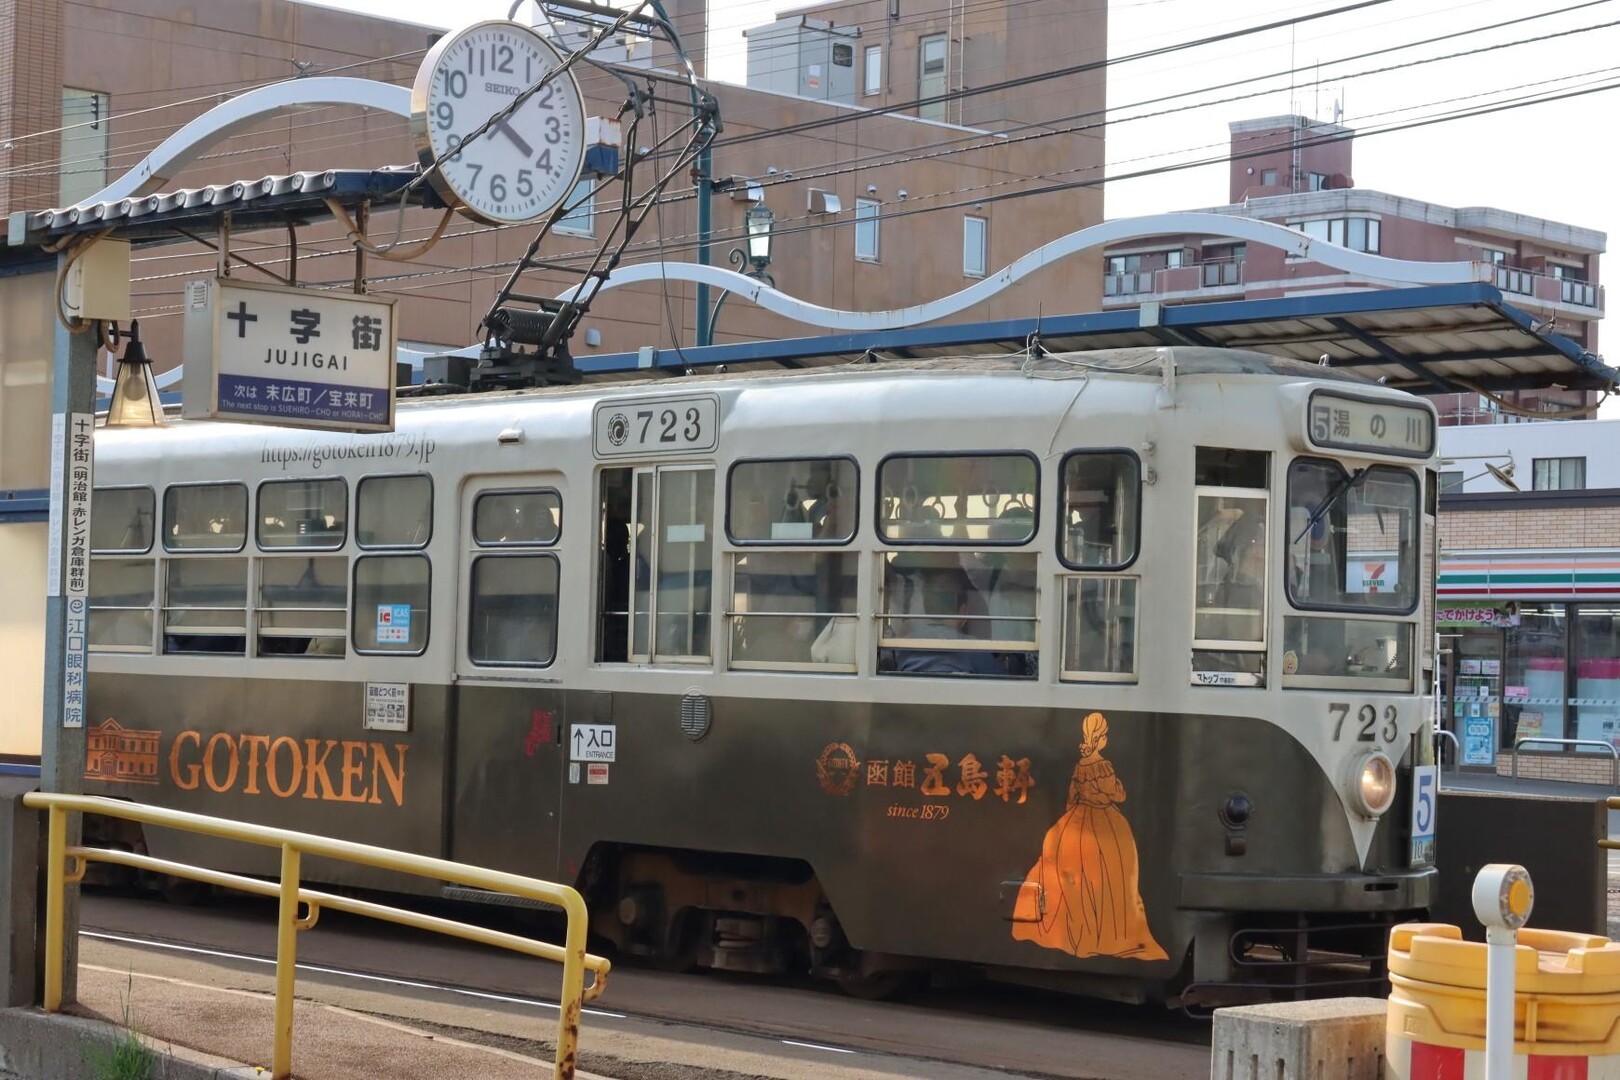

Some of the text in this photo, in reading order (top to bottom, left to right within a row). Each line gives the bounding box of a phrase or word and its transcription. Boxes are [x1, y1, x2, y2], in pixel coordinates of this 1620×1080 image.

[468, 47, 485, 77] 11
[491, 43, 514, 74] 12
[526, 56, 531, 84] 1
[443, 69, 467, 99] 10
[485, 82, 521, 97] SEIKO
[538, 81, 554, 110] 2
[436, 102, 454, 130] 9
[544, 116, 561, 145] 3
[535, 148, 553, 175] 4
[466, 163, 483, 191] 7
[490, 174, 507, 202] 6
[516, 169, 533, 197] 5
[226, 301, 383, 352] 十字街
[264, 348, 348, 371] JUJIGAI
[222, 400, 235, 409] The
[236, 402, 252, 410] next
[253, 403, 269, 412] stop
[233, 384, 258, 399] 次は
[637, 407, 701, 443] 723
[1313, 408, 1421, 446] 5 湯の川
[261, 431, 436, 470] https://gotoken1879.jp
[65, 618, 84, 723] 江口眼科病院
[1329, 702, 1398, 744] 723
[587, 728, 613, 748] 入口
[168, 730, 409, 807] GOTOKEN
[585, 750, 613, 759] ENTRANCE
[866, 751, 1036, 805] 函館 五島軒
[887, 802, 950, 821] since 1879
[1416, 774, 1433, 833] 5
